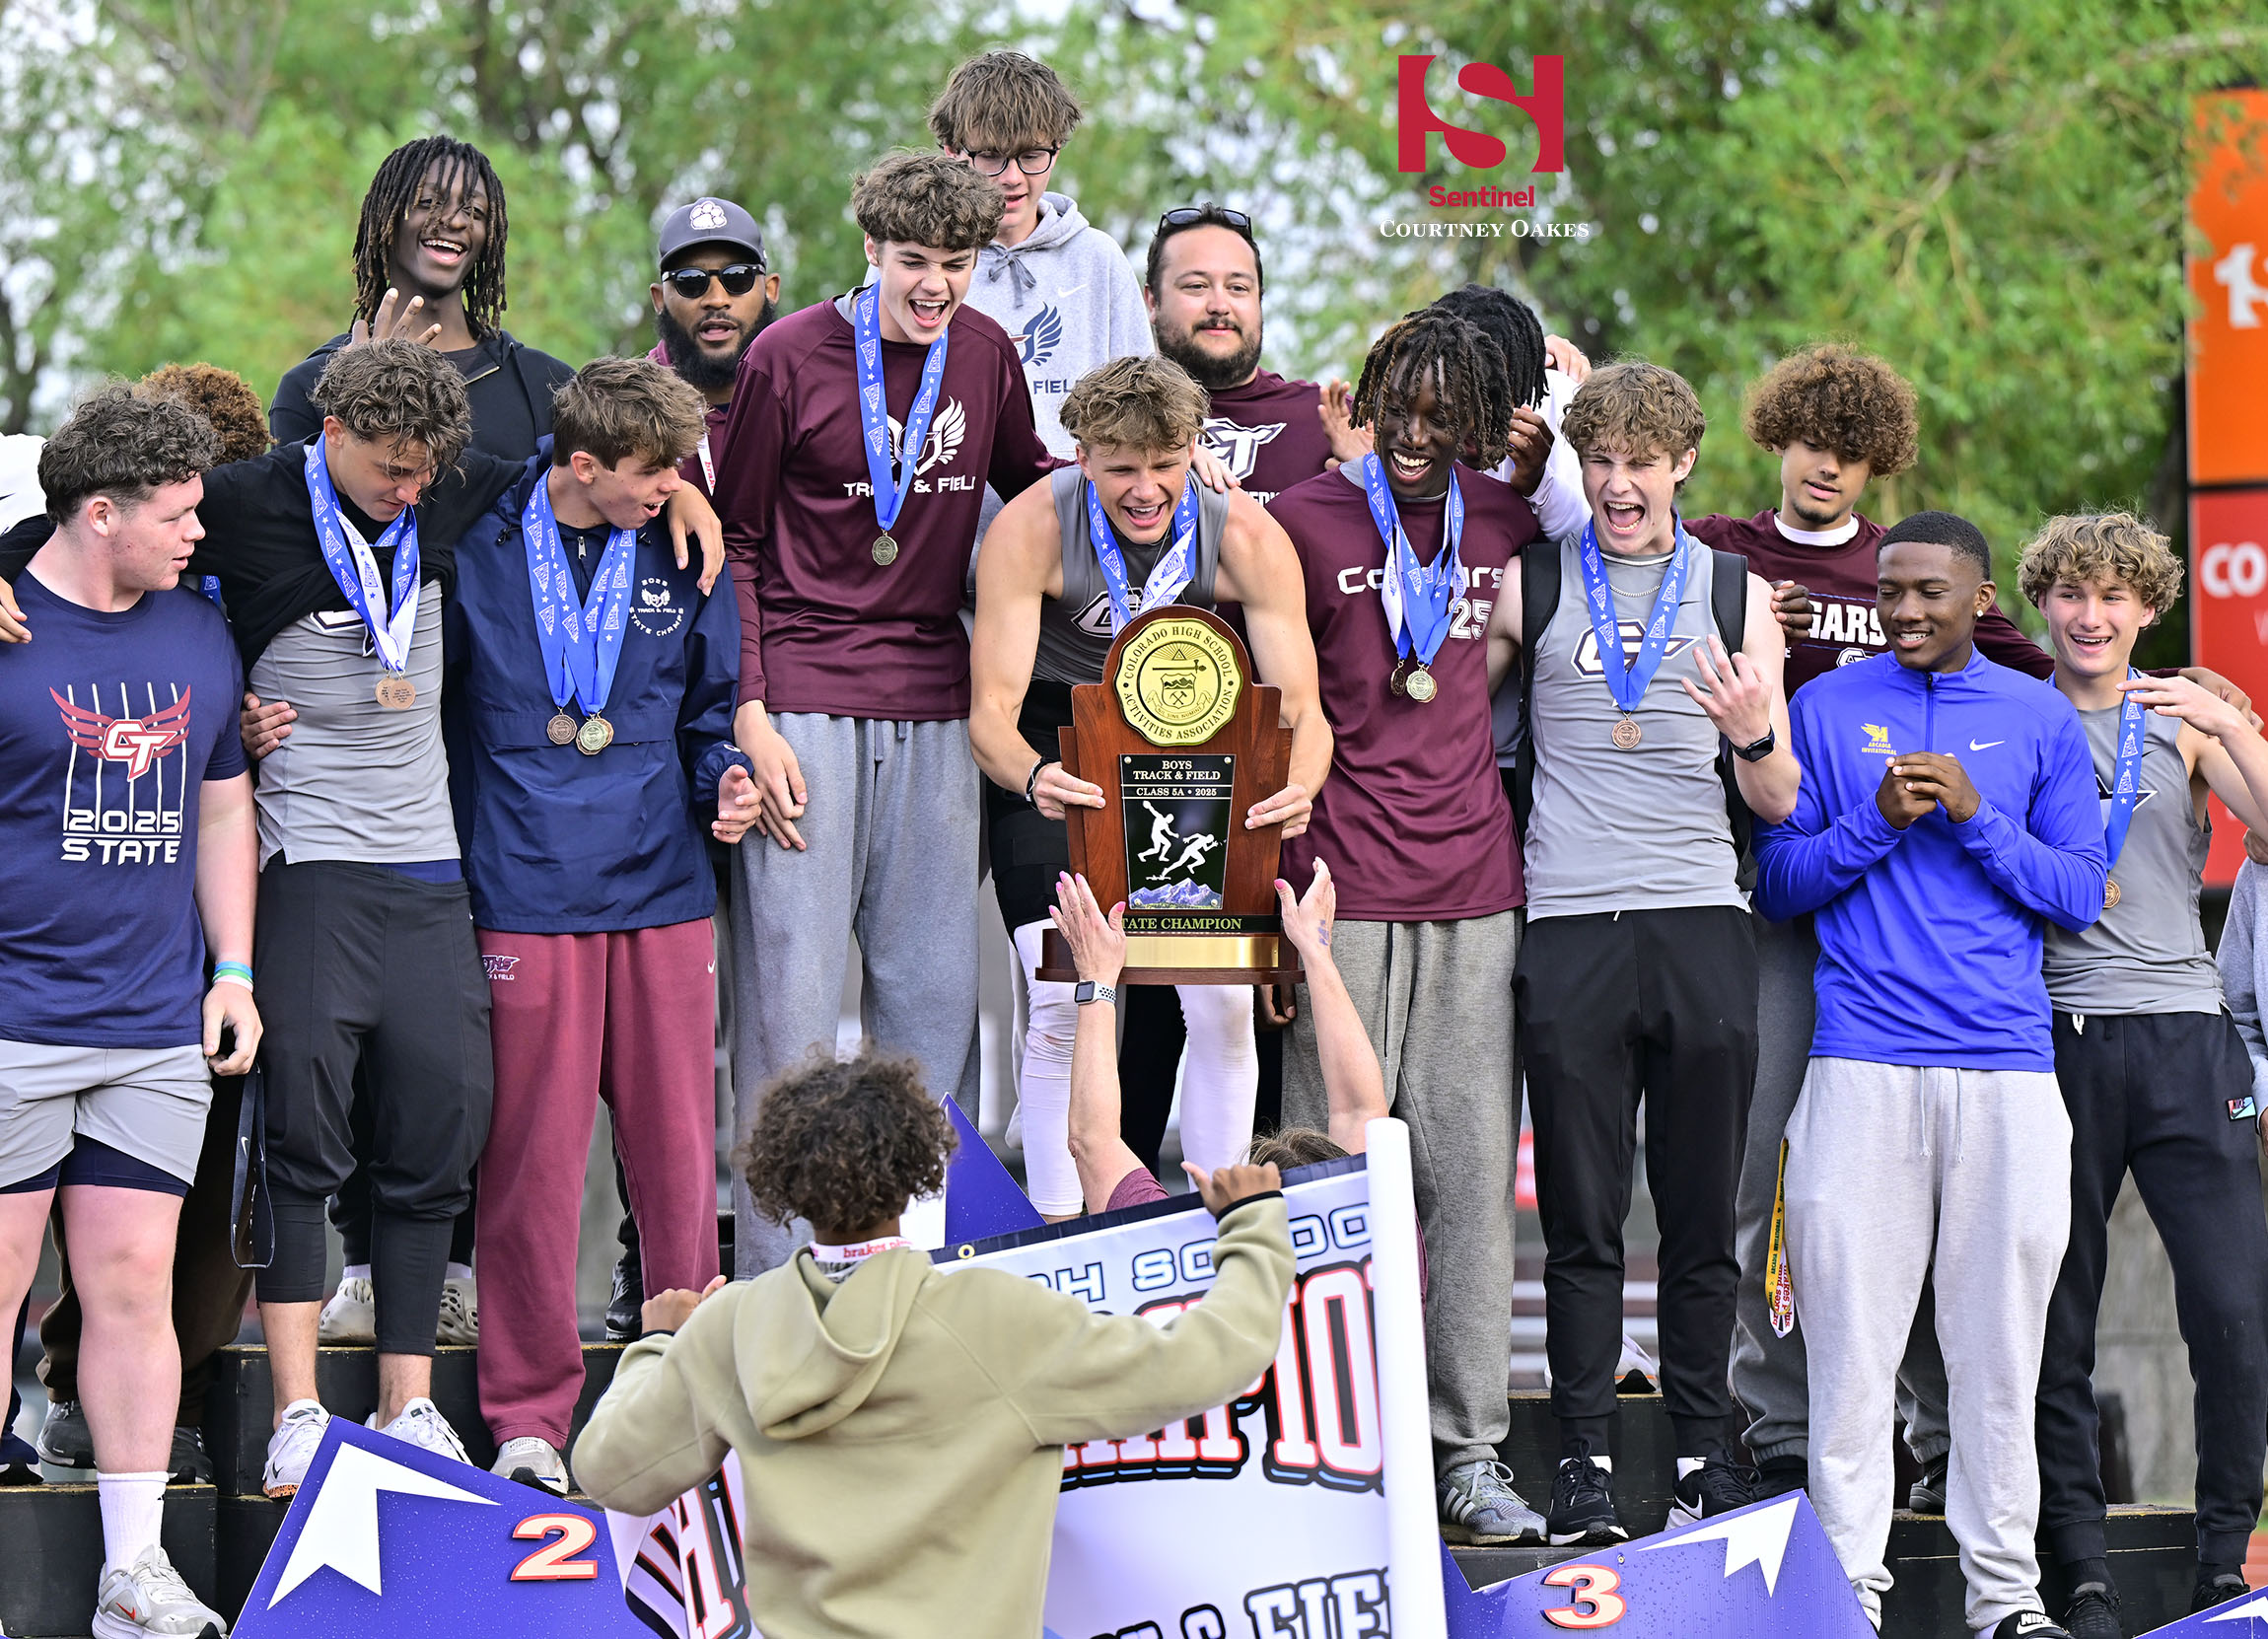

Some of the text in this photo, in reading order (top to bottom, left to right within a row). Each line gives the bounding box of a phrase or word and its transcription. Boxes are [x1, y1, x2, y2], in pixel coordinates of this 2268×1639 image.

[1033, 379, 1075, 394] FIEL
[913, 479, 932, 493] &
[1124, 626, 1233, 679] COLORADO HIGH SCHOOL
[1123, 689, 1234, 740] ACTIVITIES ASSOCIATION
[1162, 760, 1192, 770] BOYS
[1133, 770, 1221, 780] TRACK & FIELD
[1195, 788, 1217, 797] 2025
[69, 809, 180, 833] 2025
[60, 837, 180, 866] STATE
[1122, 918, 1241, 930] TATE CHAMPION
[511, 1513, 598, 1581] 2
[1540, 1564, 1627, 1629] 3
[2020, 1612, 2052, 1626] NIKE
